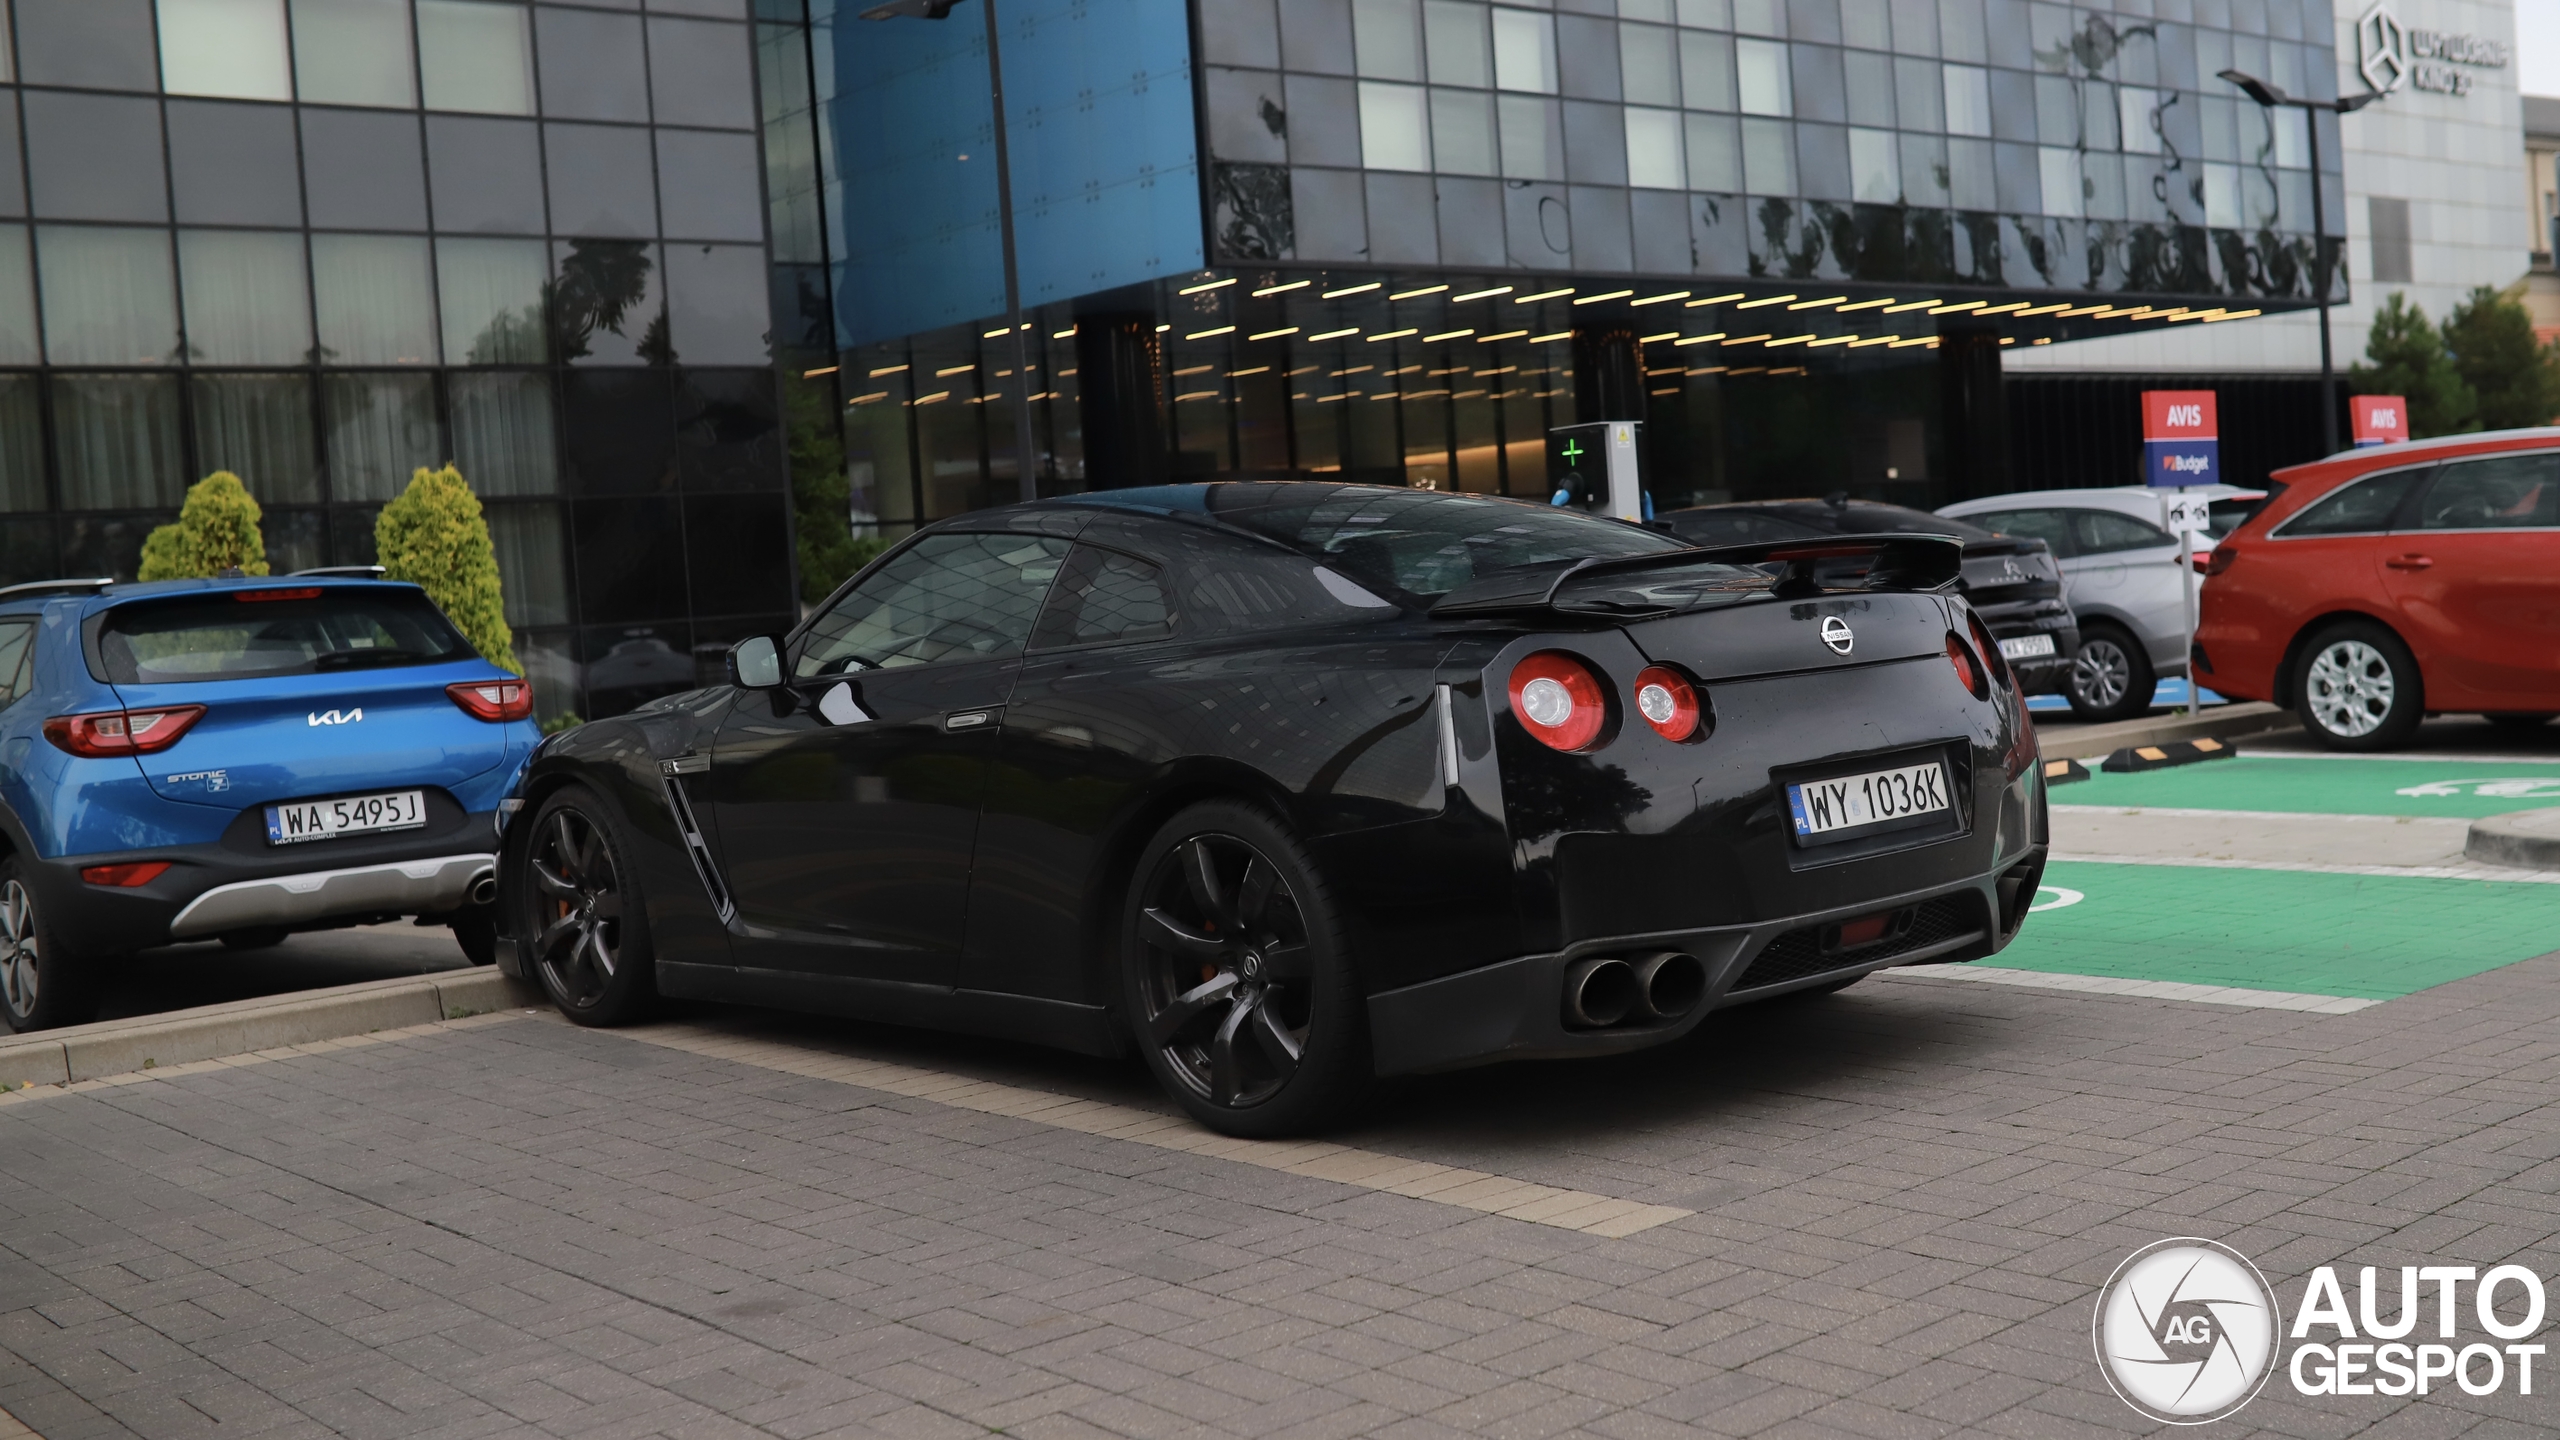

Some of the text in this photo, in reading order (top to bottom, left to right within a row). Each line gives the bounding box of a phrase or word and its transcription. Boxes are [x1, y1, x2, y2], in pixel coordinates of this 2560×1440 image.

[2167, 405, 2202, 427] AVIS
[2371, 408, 2397, 429] AVIS
[2175, 455, 2209, 475] Budget
[1826, 630, 1852, 640] NISSAN
[307, 707, 363, 727] KIA
[167, 769, 226, 783] STONIC
[1807, 767, 1945, 829] WY 1036K
[285, 794, 416, 835] WA 5495J
[1795, 817, 1808, 830] PL
[269, 826, 280, 836] PL
